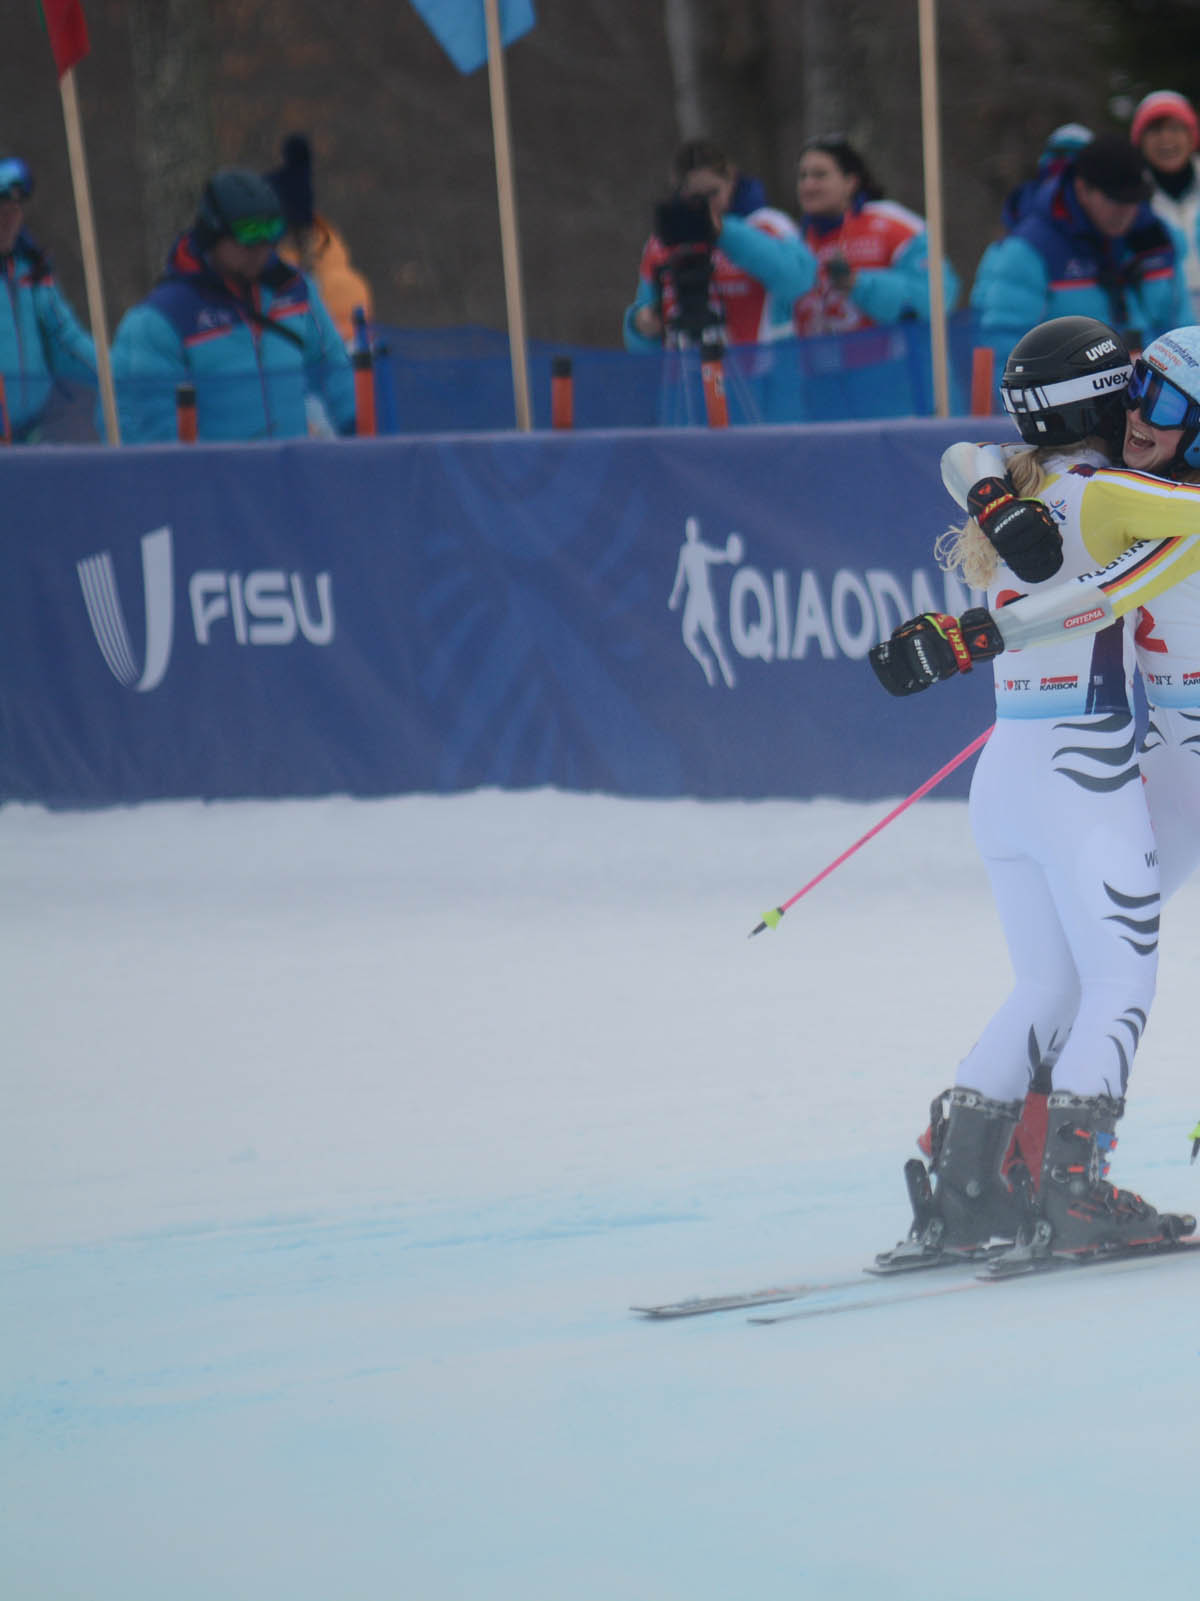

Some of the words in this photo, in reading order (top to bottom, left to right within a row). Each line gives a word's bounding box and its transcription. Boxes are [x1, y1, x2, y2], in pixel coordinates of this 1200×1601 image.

[1085, 339, 1117, 361] uvex
[1092, 371, 1129, 390] uvex
[188, 570, 336, 646] FISU
[1065, 609, 1103, 628] ORTEMA
[948, 629, 969, 660] LEKI
